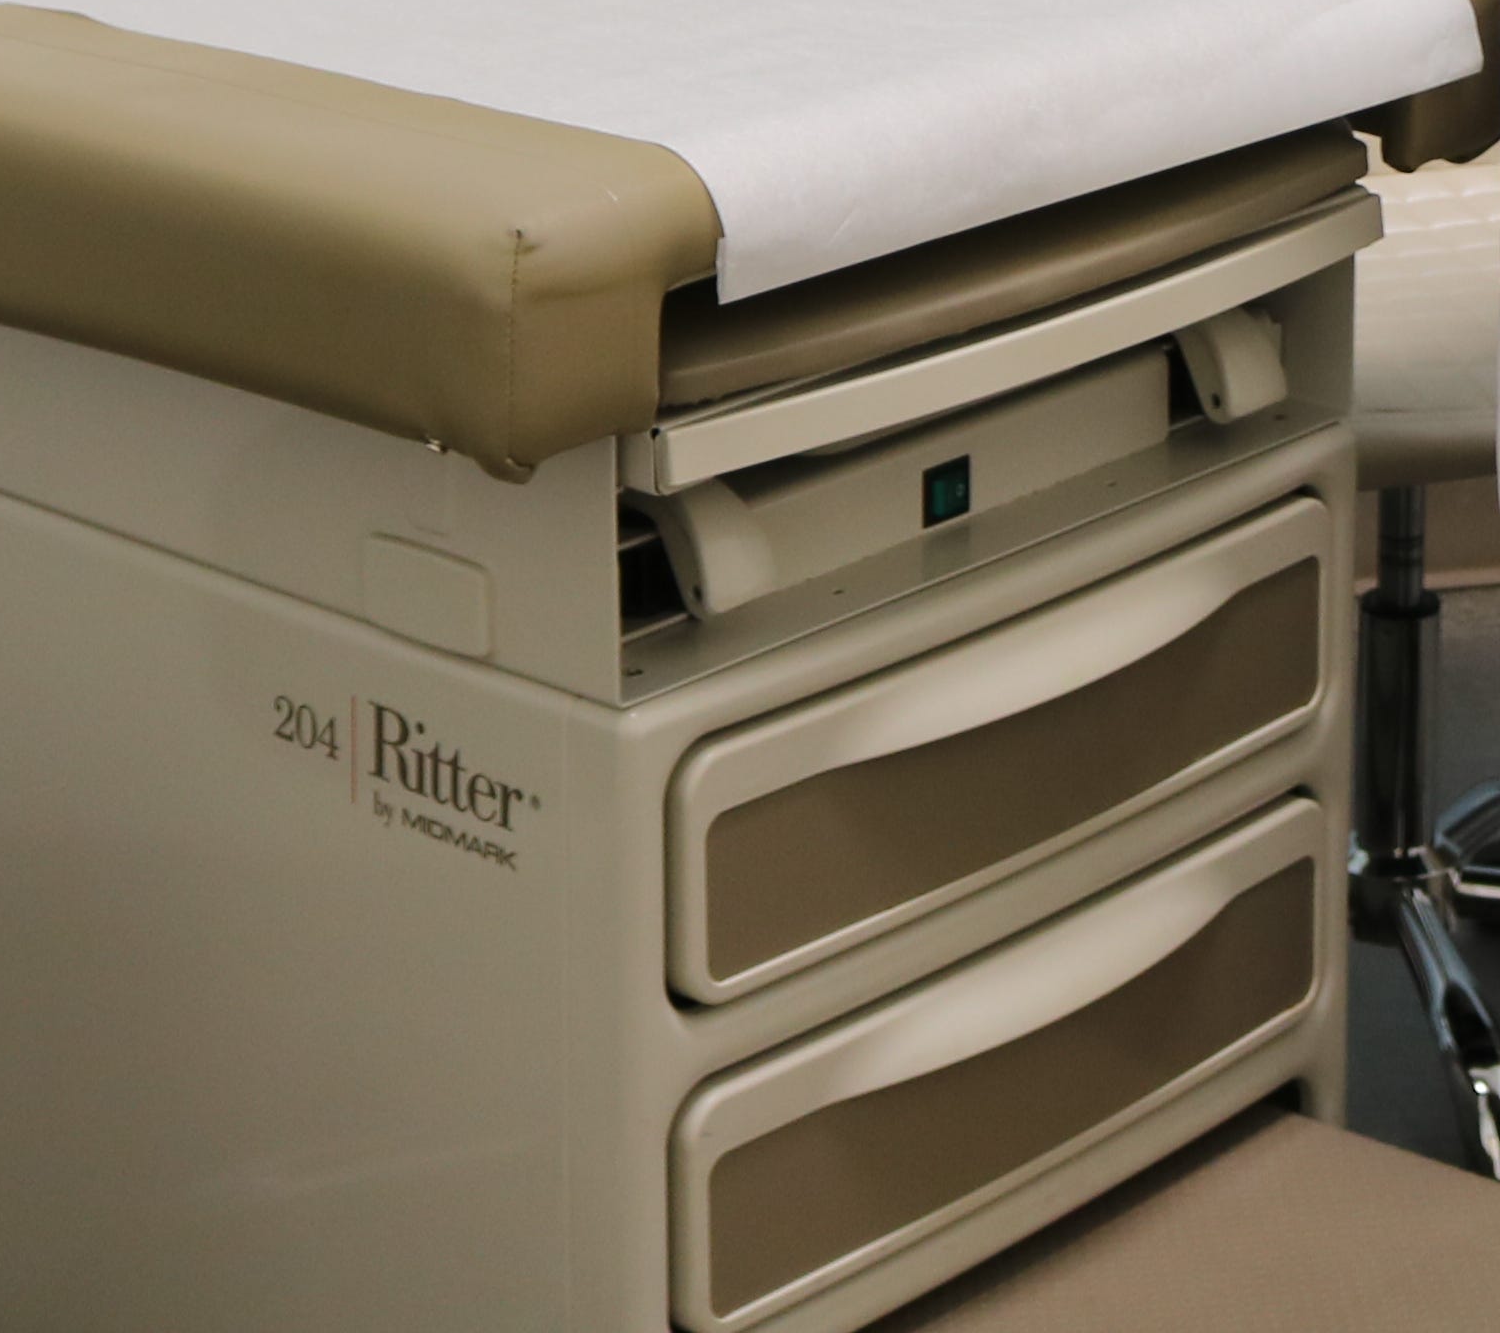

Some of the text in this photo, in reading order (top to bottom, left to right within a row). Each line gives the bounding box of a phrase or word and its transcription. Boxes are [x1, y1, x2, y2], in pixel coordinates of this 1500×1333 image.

[273, 694, 340, 761] 204
[373, 789, 519, 872] by MIDMARK
